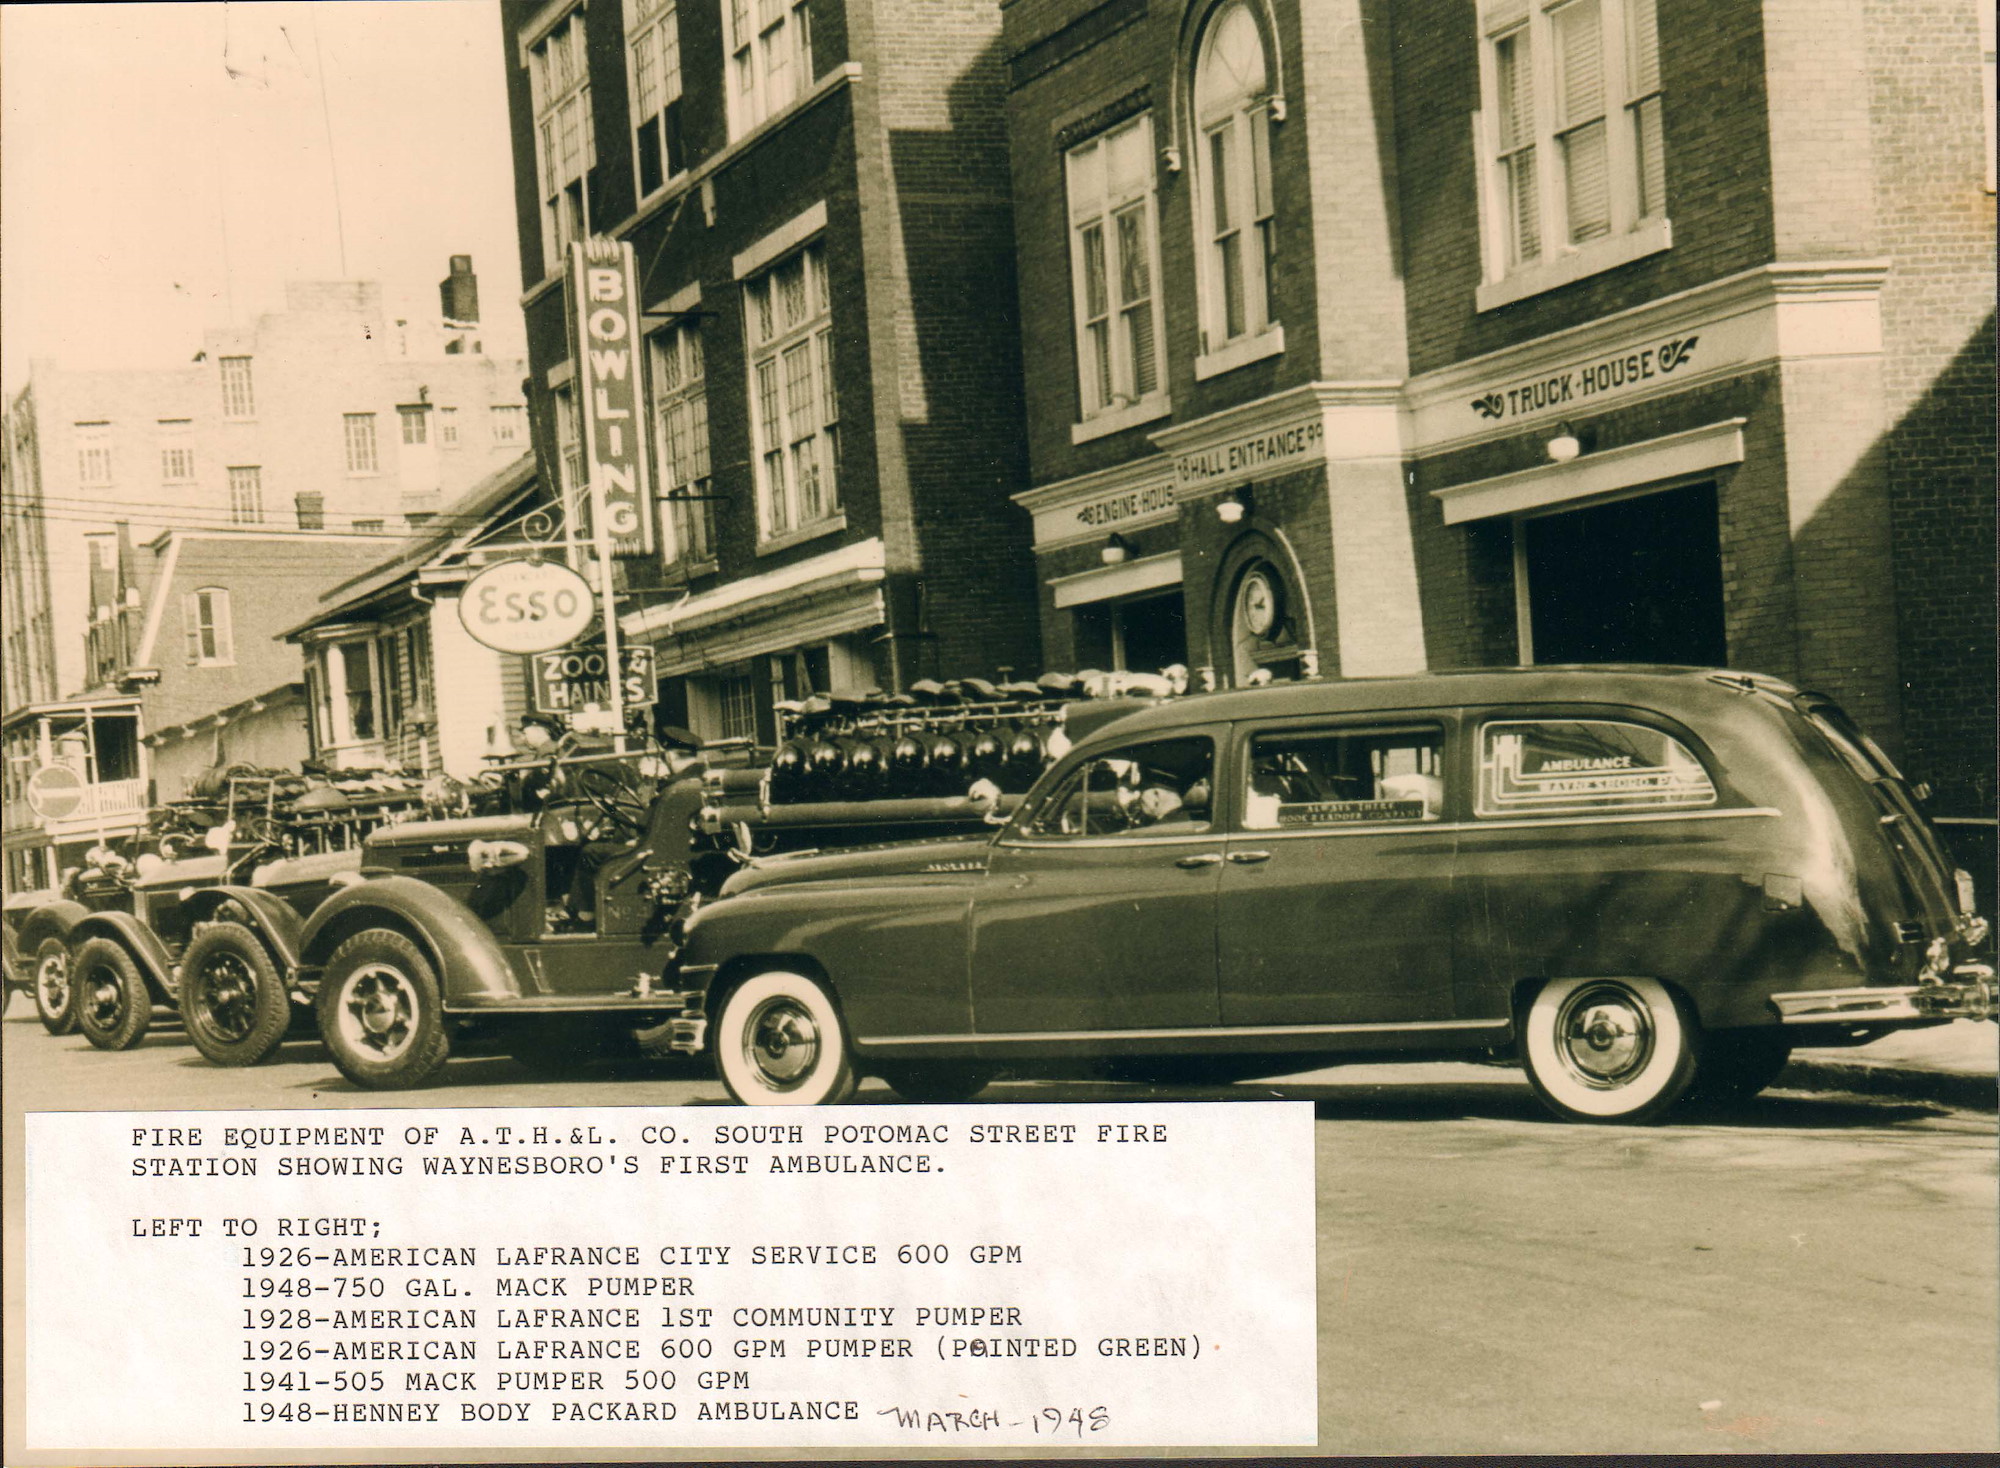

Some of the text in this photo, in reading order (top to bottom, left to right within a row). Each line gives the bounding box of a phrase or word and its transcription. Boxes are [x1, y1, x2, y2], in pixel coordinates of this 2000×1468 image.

[588, 268, 639, 534] BOWLING
[1190, 451, 1225, 479] HALL
[1229, 427, 1305, 471] ENTRANCE
[479, 585, 578, 625] ESSO
[542, 652, 625, 680] ZOO
[548, 677, 645, 708] HAINS
[1540, 756, 1631, 772] AMBULANCE
